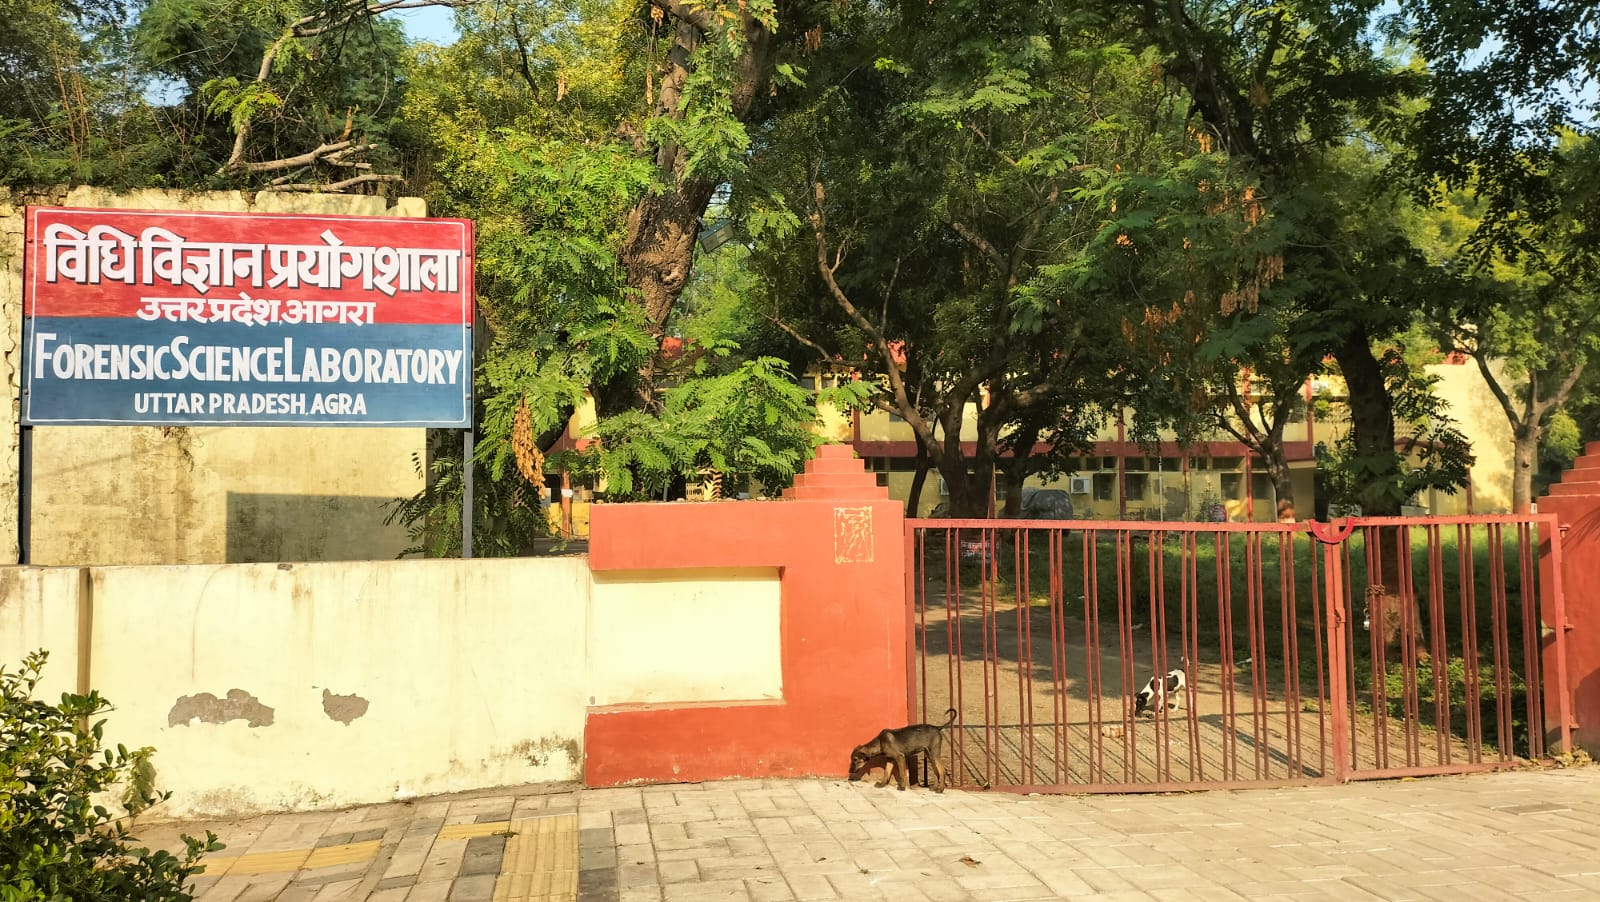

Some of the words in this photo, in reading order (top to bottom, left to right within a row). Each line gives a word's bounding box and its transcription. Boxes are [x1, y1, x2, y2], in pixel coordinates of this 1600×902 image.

[43, 223, 138, 284] विधि
[138, 226, 265, 293] विज्ञान
[266, 228, 461, 297] प्रयोगशाला
[136, 297, 207, 324] उत्तर
[281, 299, 376, 327] आगरा
[134, 392, 205, 414] UTTAR
[309, 392, 368, 415] AGRA
